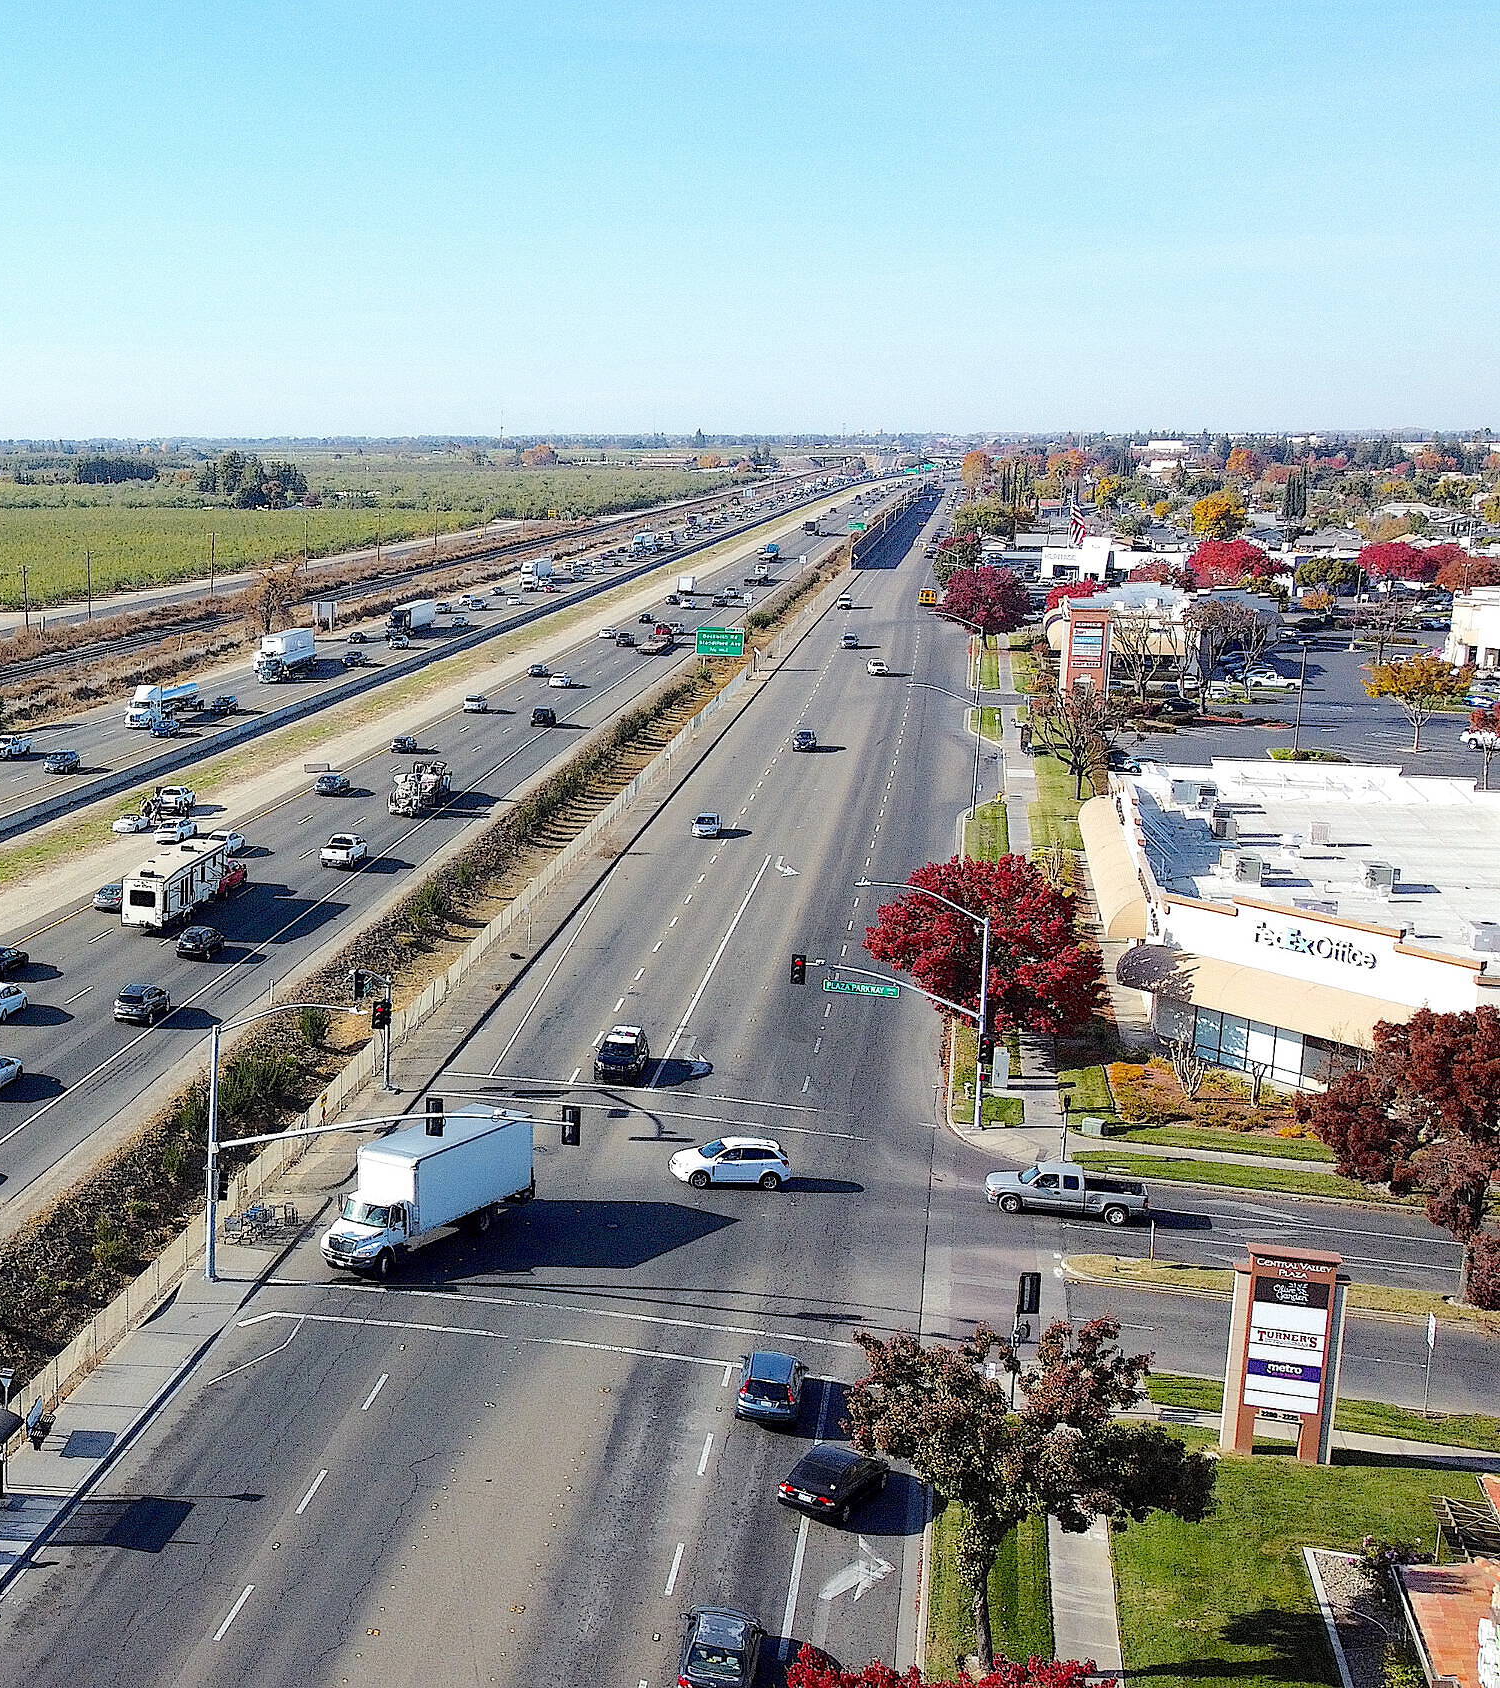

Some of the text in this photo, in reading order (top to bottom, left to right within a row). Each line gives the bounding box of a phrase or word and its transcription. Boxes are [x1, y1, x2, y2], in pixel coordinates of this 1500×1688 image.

[1316, 937, 1377, 970] Office
[826, 982, 850, 990] PLAZA
[851, 985, 884, 994] PARKWAY
[1256, 1257, 1333, 1273] CENTRAL VALLEY
[1278, 1269, 1308, 1279] PLAZA
[1276, 1291, 1309, 1302] Garden
[1257, 1329, 1318, 1348] TURNER'S
[1266, 1363, 1303, 1374] metro
